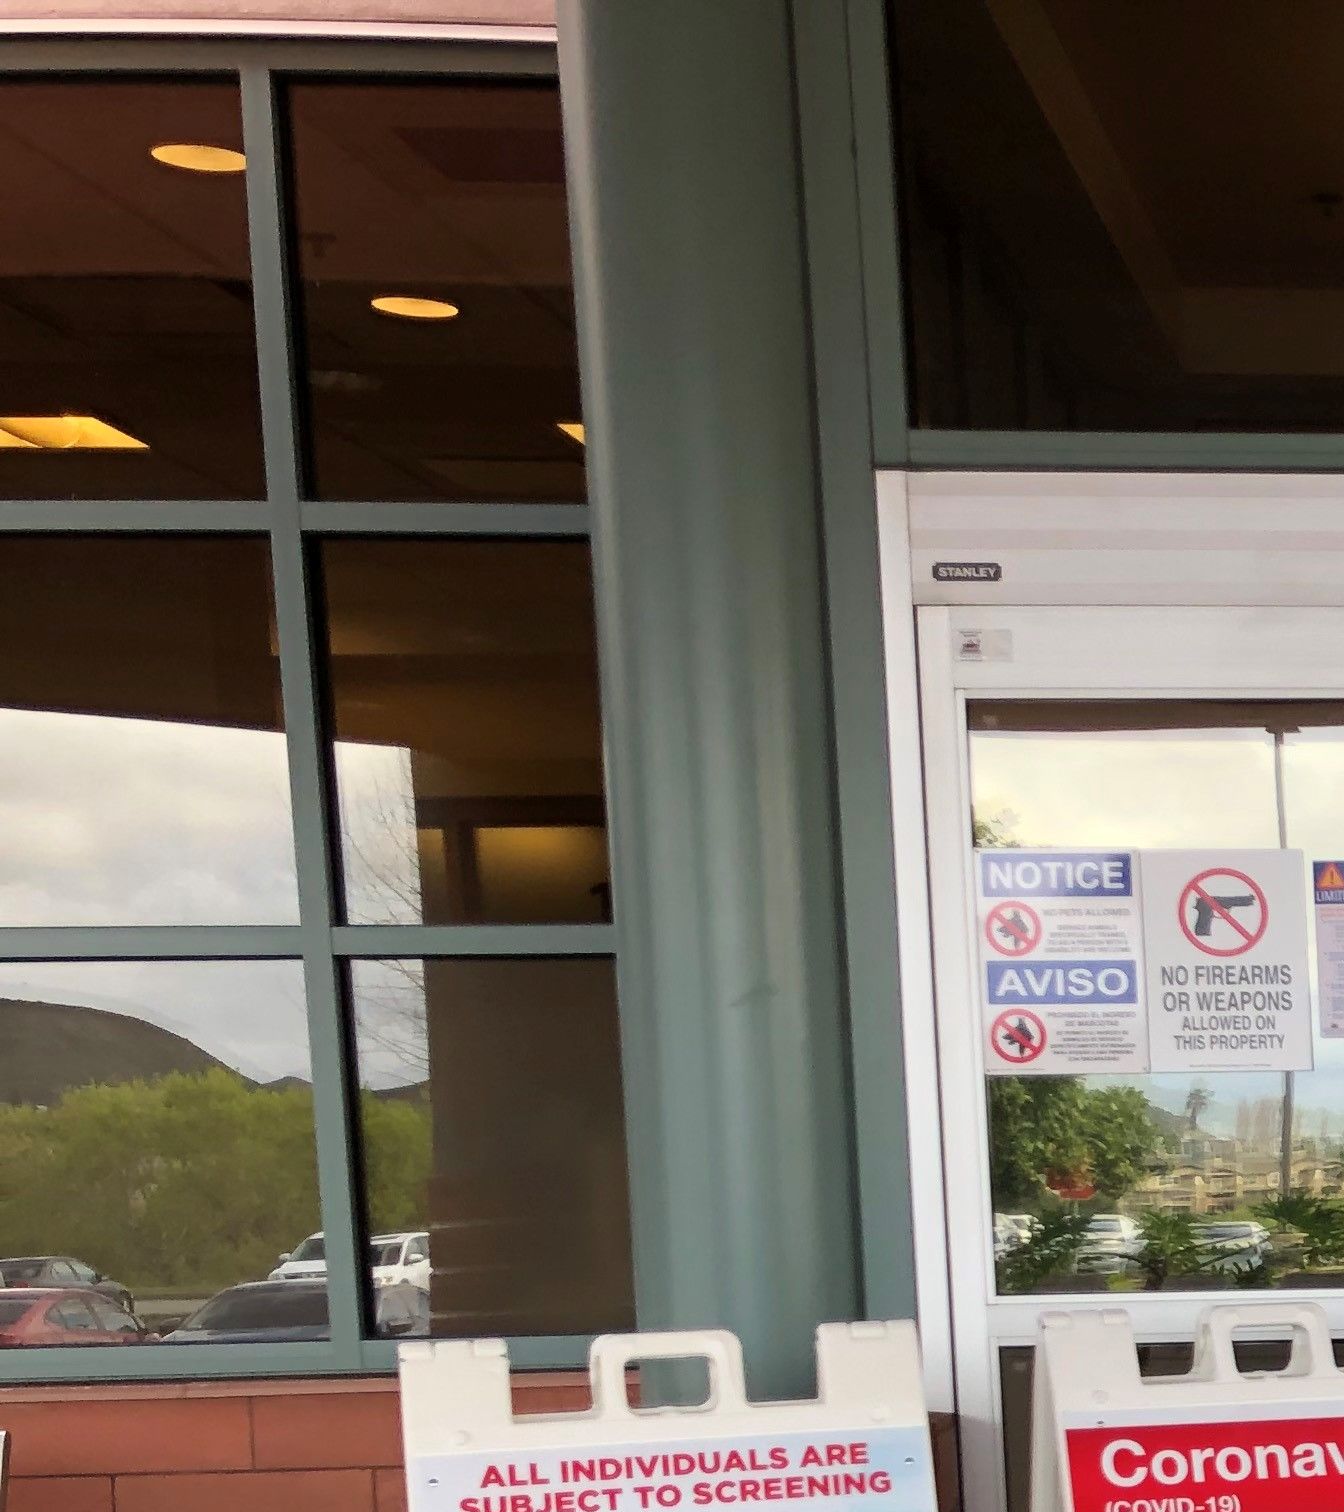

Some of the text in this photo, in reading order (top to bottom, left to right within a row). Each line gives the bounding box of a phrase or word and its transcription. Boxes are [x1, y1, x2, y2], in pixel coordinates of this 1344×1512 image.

[938, 567, 996, 578] STANLEY
[989, 861, 1125, 889] NOTICE
[995, 968, 1130, 997] AVISO
[1161, 964, 1292, 985] NO FIREARMS
[1163, 991, 1293, 1012] OR WEAPONS
[1182, 1015, 1276, 1031] ALLOWED ON
[1174, 1034, 1285, 1050] THIS PROPERTY
[480, 1443, 868, 1488] ALL INDIVIDUALS ARE
[633, 1484, 681, 1508] TO
[693, 1471, 891, 1504] SCREENING
